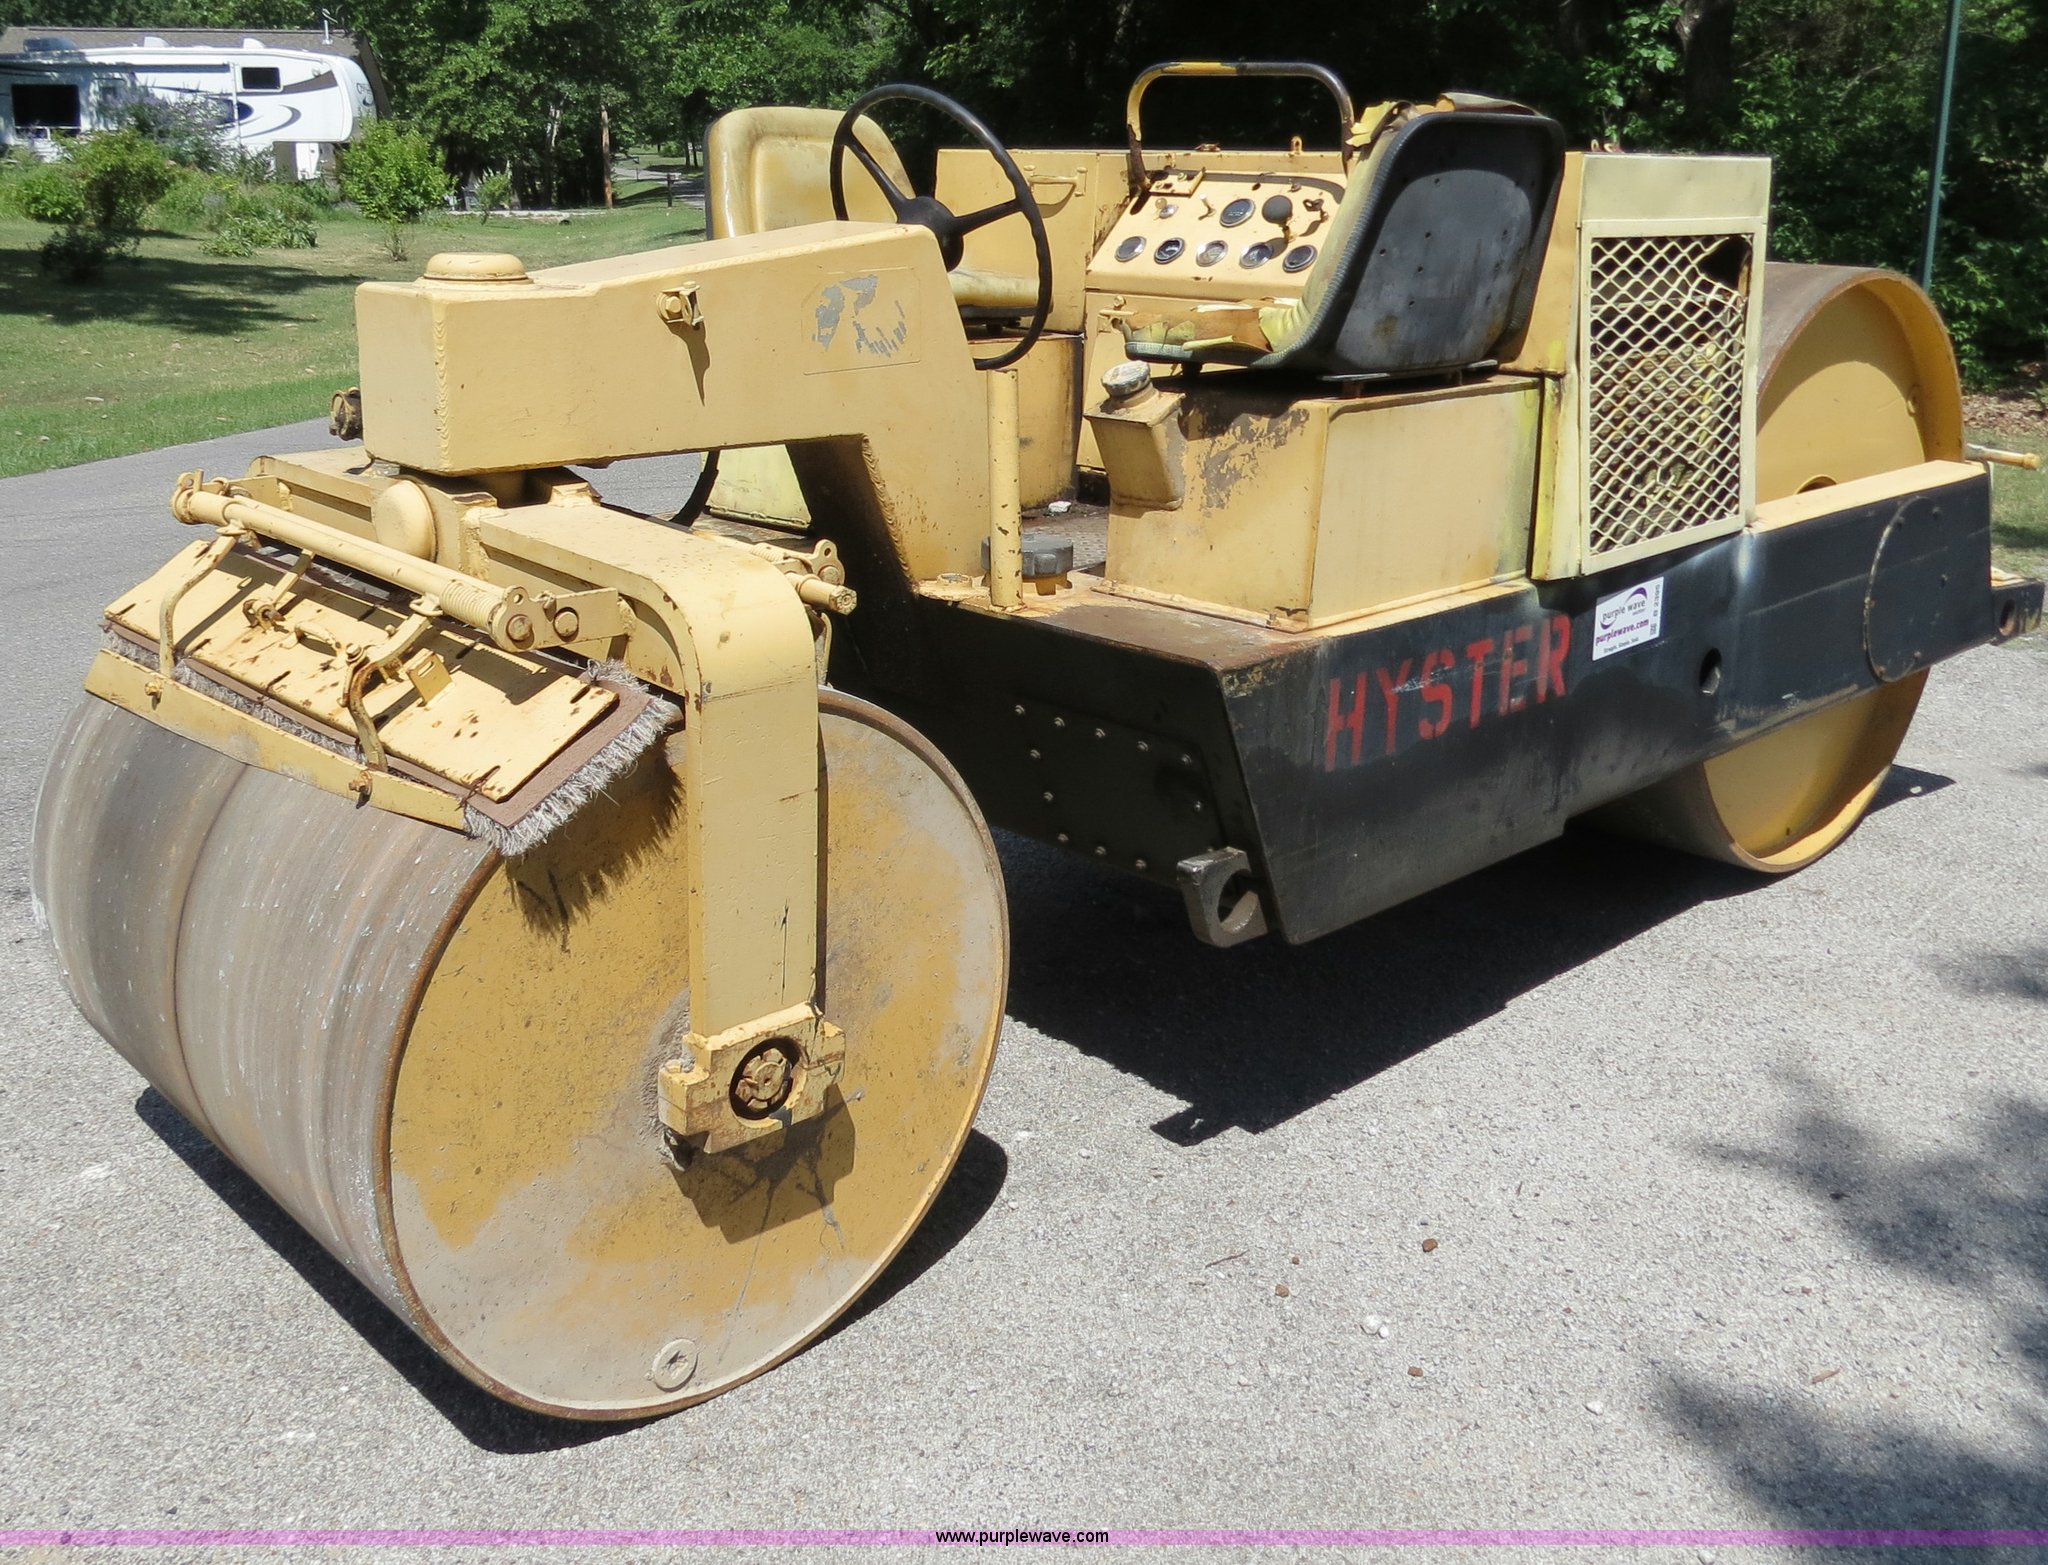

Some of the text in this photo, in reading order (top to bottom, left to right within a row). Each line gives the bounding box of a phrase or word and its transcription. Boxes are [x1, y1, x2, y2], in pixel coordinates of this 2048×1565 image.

[1602, 605, 1626, 621] purple
[1627, 600, 1646, 612] wave
[1595, 619, 1649, 647] purplewave.com
[1325, 613, 1572, 772] HYSTER
